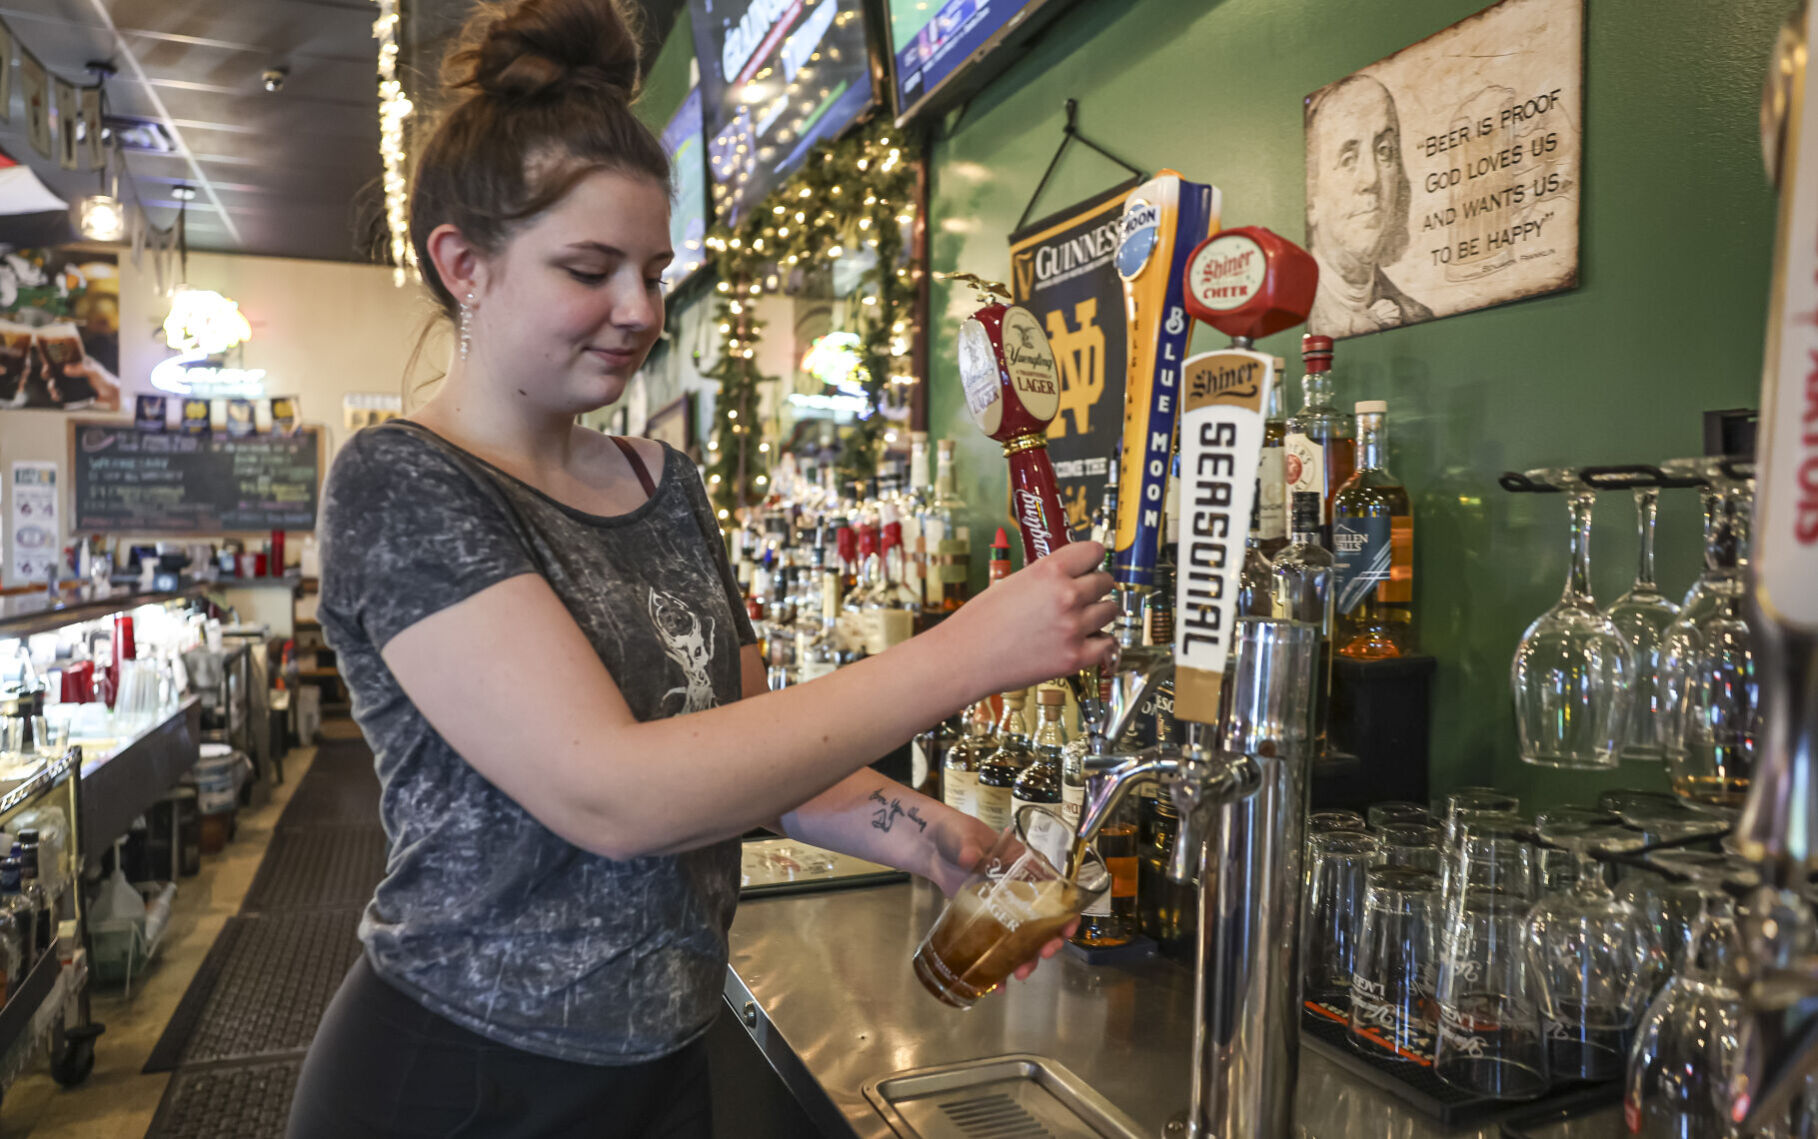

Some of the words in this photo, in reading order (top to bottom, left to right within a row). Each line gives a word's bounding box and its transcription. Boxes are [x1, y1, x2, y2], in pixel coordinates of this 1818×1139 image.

[1477, 117, 1492, 137] IS
[1500, 88, 1561, 129] PROOF
[1425, 168, 1462, 193] GOD
[1467, 145, 1522, 180] LOVES
[1531, 132, 1557, 157] US
[1422, 208, 1457, 232] AND
[1462, 184, 1525, 219] WANTS
[1533, 173, 1560, 197] US
[1203, 250, 1255, 283] Shiner
[1431, 247, 1452, 266] TO
[1457, 237, 1480, 260] BE
[1203, 285, 1248, 299] CHEER
[1157, 306, 1184, 413] BLUE
[1190, 362, 1259, 398] Shiner
[1017, 376, 1056, 395] LAGER
[1144, 431, 1168, 528] MOON
[1183, 421, 1236, 655] SEASONAL
